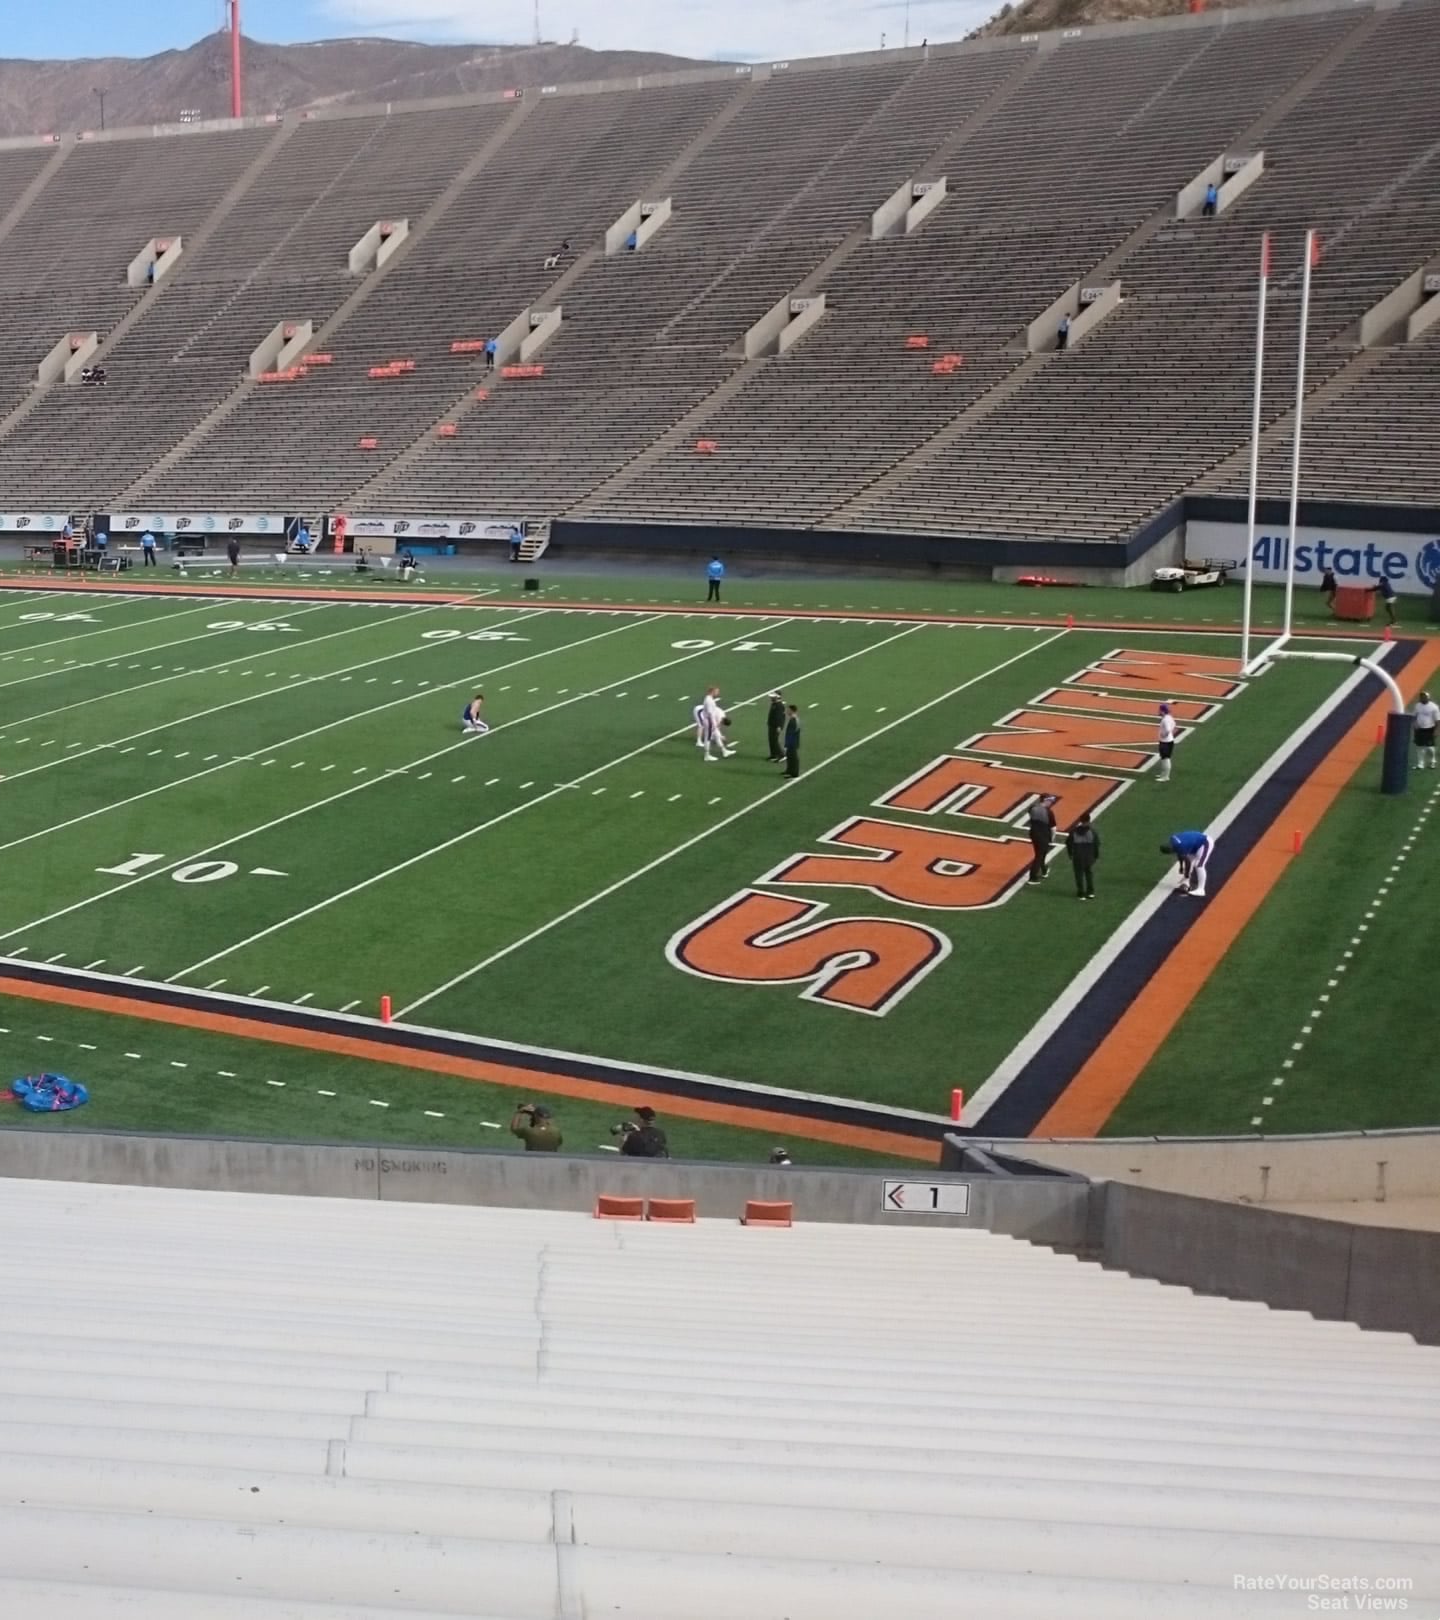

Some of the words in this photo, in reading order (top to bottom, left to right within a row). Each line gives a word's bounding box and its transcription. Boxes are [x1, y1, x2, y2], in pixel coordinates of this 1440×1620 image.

[1240, 536, 1408, 580] Allstate
[664, 648, 1275, 1018] MINERS
[94, 853, 239, 883] 10
[929, 1187, 938, 1209] 1
